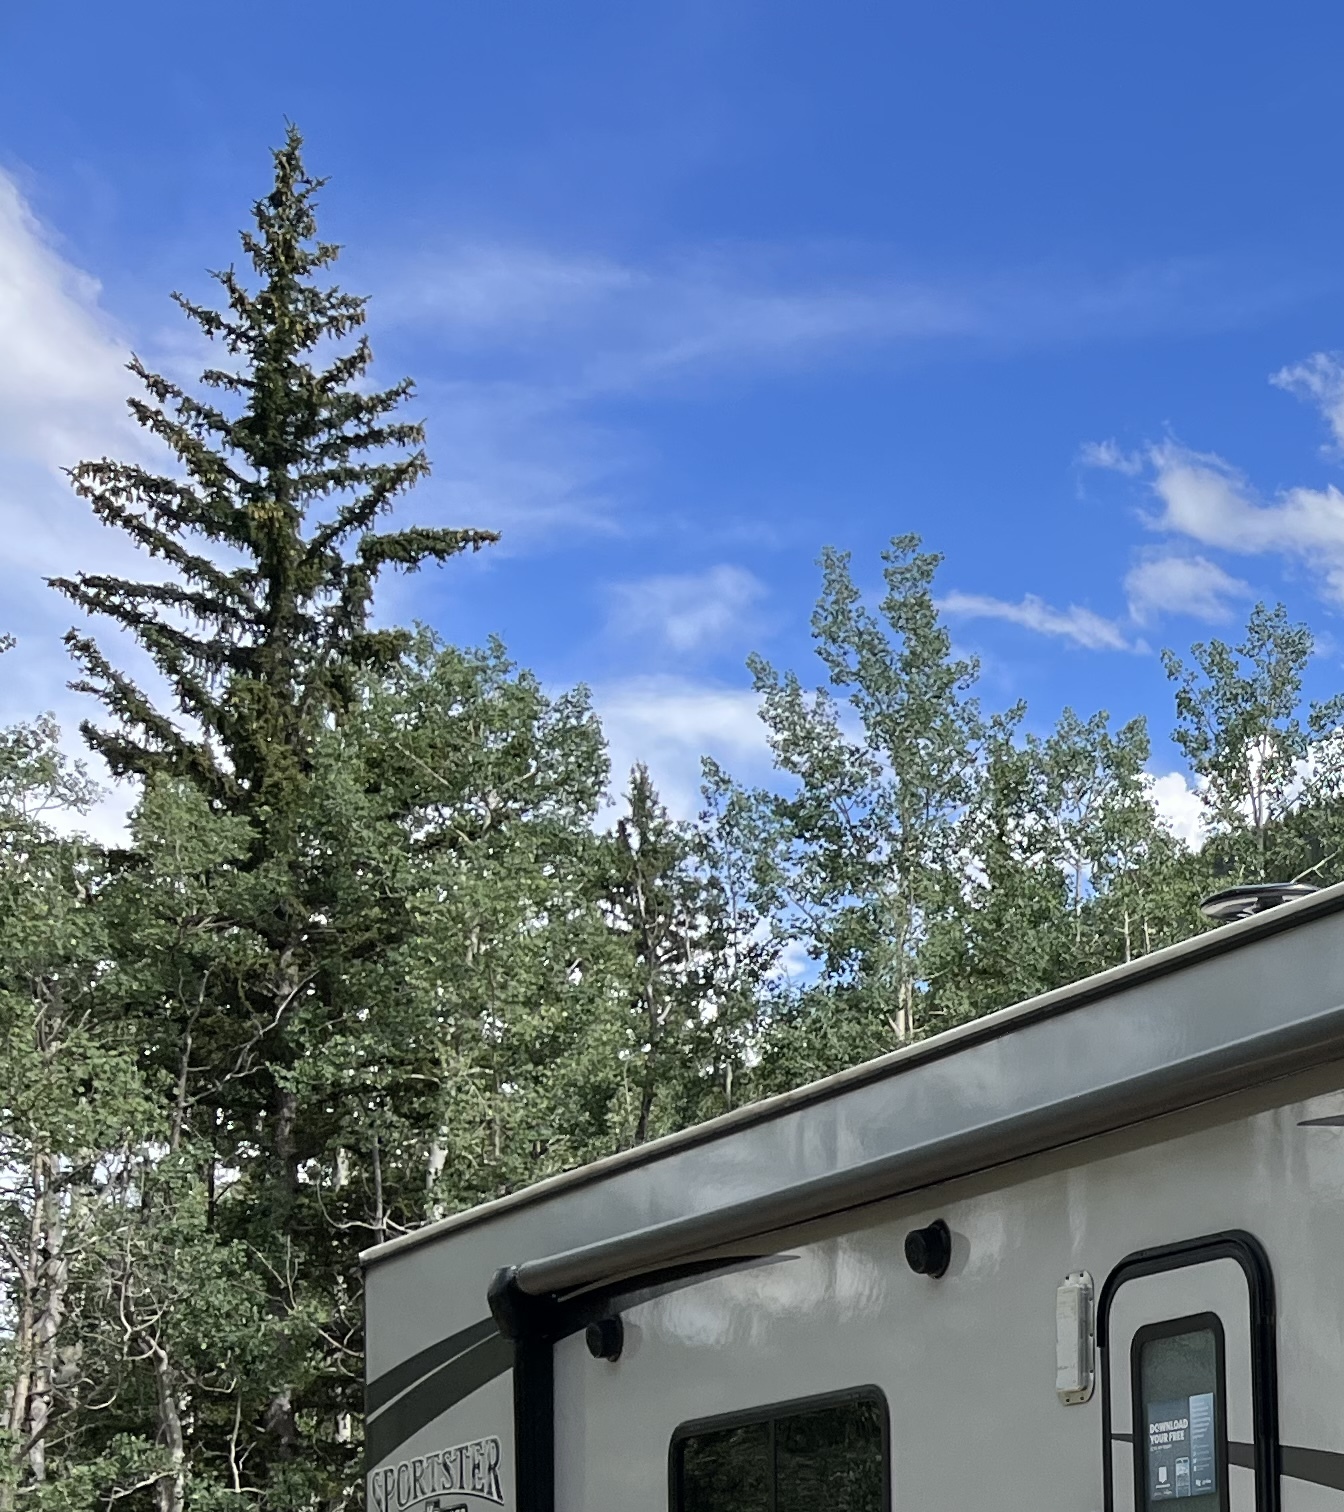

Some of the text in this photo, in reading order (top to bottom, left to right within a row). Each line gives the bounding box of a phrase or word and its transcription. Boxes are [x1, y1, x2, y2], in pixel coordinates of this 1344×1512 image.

[1149, 1418, 1189, 1434] DOWNLOAD
[1149, 1430, 1185, 1445] YOUR FREE
